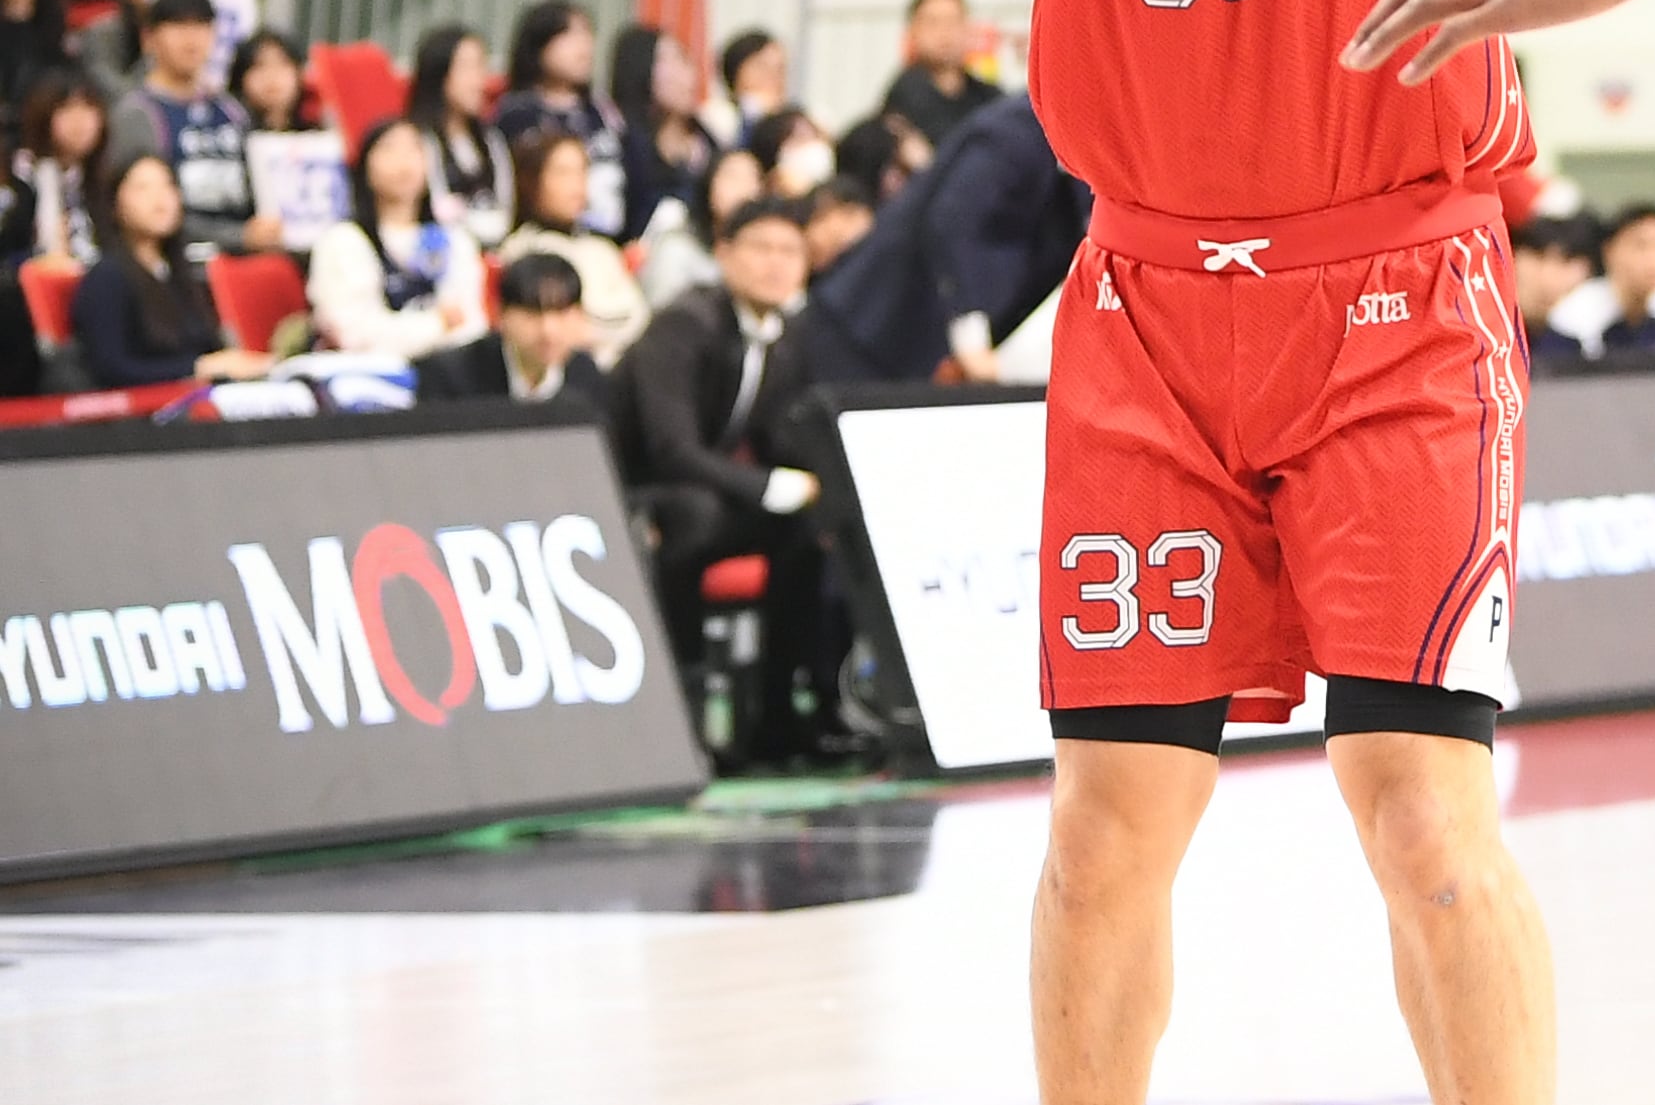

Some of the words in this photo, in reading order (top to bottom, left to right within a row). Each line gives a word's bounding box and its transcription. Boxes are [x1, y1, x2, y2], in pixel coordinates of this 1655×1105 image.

[0, 599, 247, 710] YUNDAI
[227, 514, 646, 733] MOBIS
[1060, 528, 1224, 651] 33
